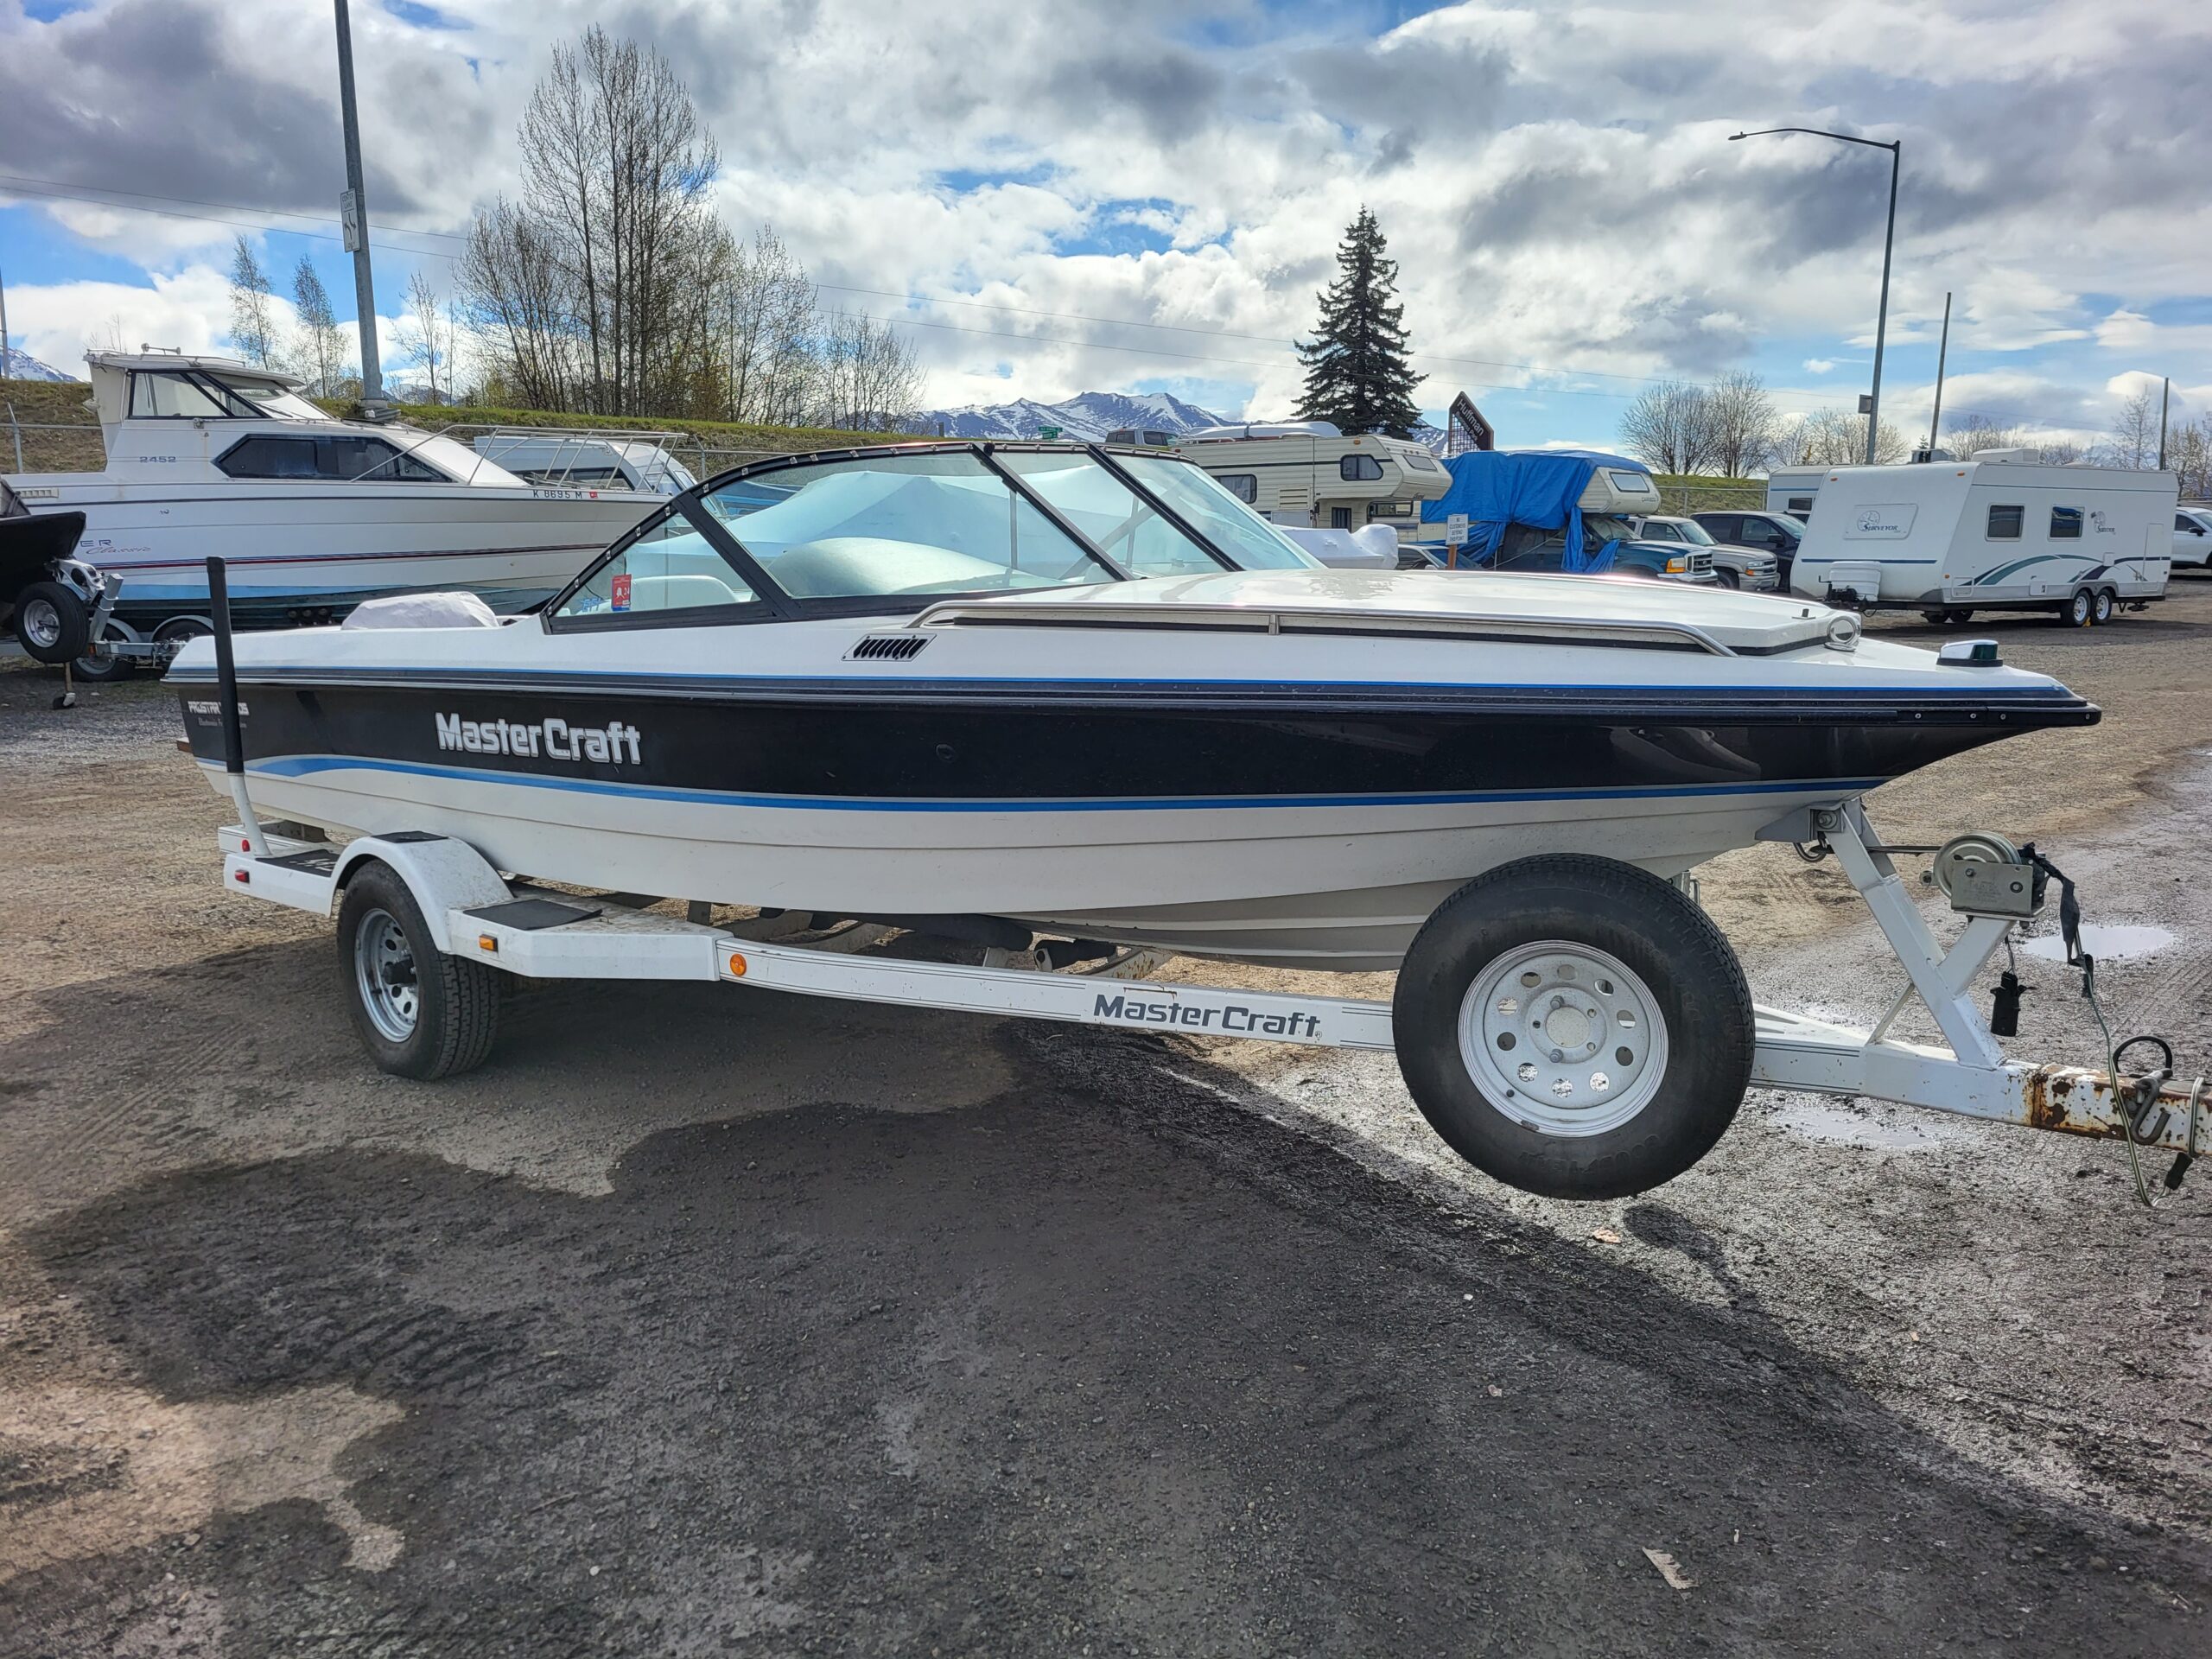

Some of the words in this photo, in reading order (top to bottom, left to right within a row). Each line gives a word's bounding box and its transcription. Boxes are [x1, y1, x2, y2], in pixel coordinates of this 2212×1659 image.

[1457, 398, 1484, 436] Huffman
[543, 490, 571, 499] 8695
[435, 712, 641, 765] MasterCraft
[1093, 994, 1322, 1038] MasterCraft
